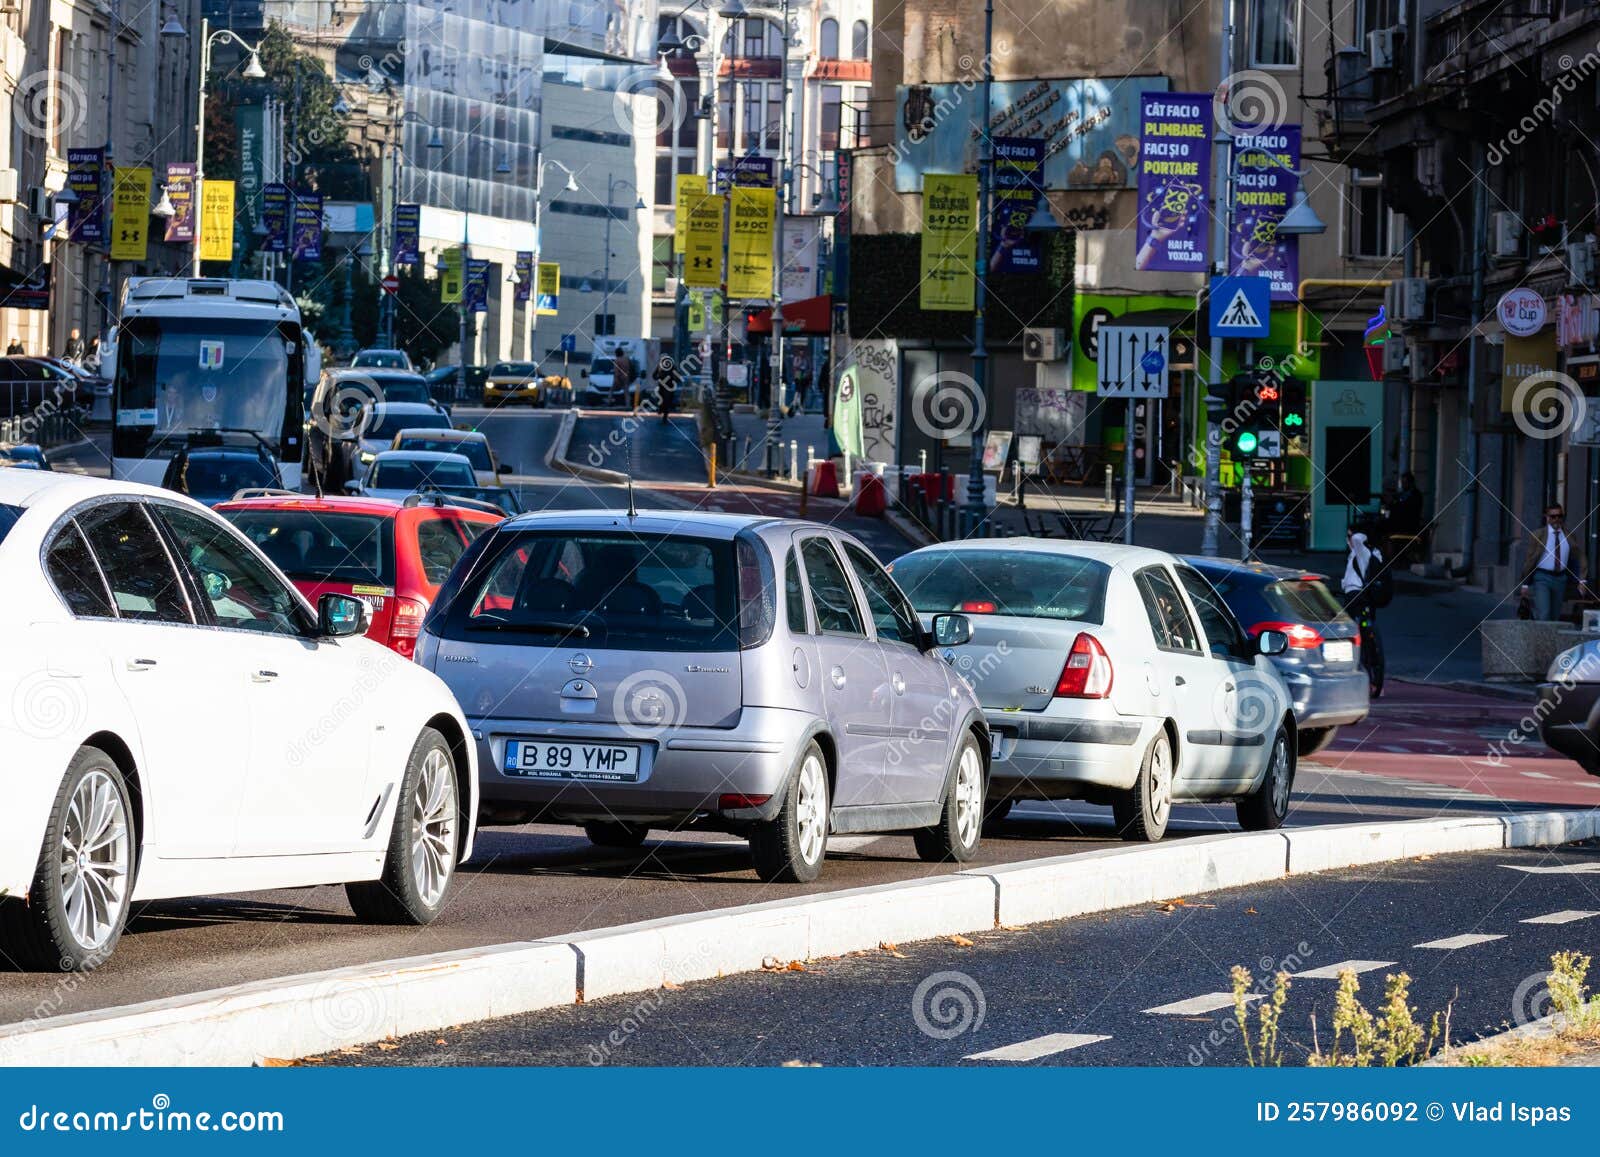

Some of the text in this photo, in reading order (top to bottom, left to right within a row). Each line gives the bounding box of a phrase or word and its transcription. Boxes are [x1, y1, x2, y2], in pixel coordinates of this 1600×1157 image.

[1145, 102, 1200, 117] CÂT FACI O
[1145, 122, 1206, 138] PLIMBARE,
[1235, 134, 1288, 148] CÂT FACI O
[1144, 142, 1168, 156] FACI
[1181, 144, 1189, 156] O
[1143, 161, 1198, 175] PORTARE
[1269, 174, 1277, 186] O
[1236, 192, 1286, 205] PORTARE
[735, 221, 768, 229] 8-9 OCT
[929, 215, 969, 224] 8-9 OCT
[1168, 240, 1194, 250] HAI PE
[1168, 251, 1203, 262] YOXO.RO
[1519, 297, 1540, 308] First
[1519, 308, 1537, 321] Cup
[523, 745, 627, 770] B 89 YMP
